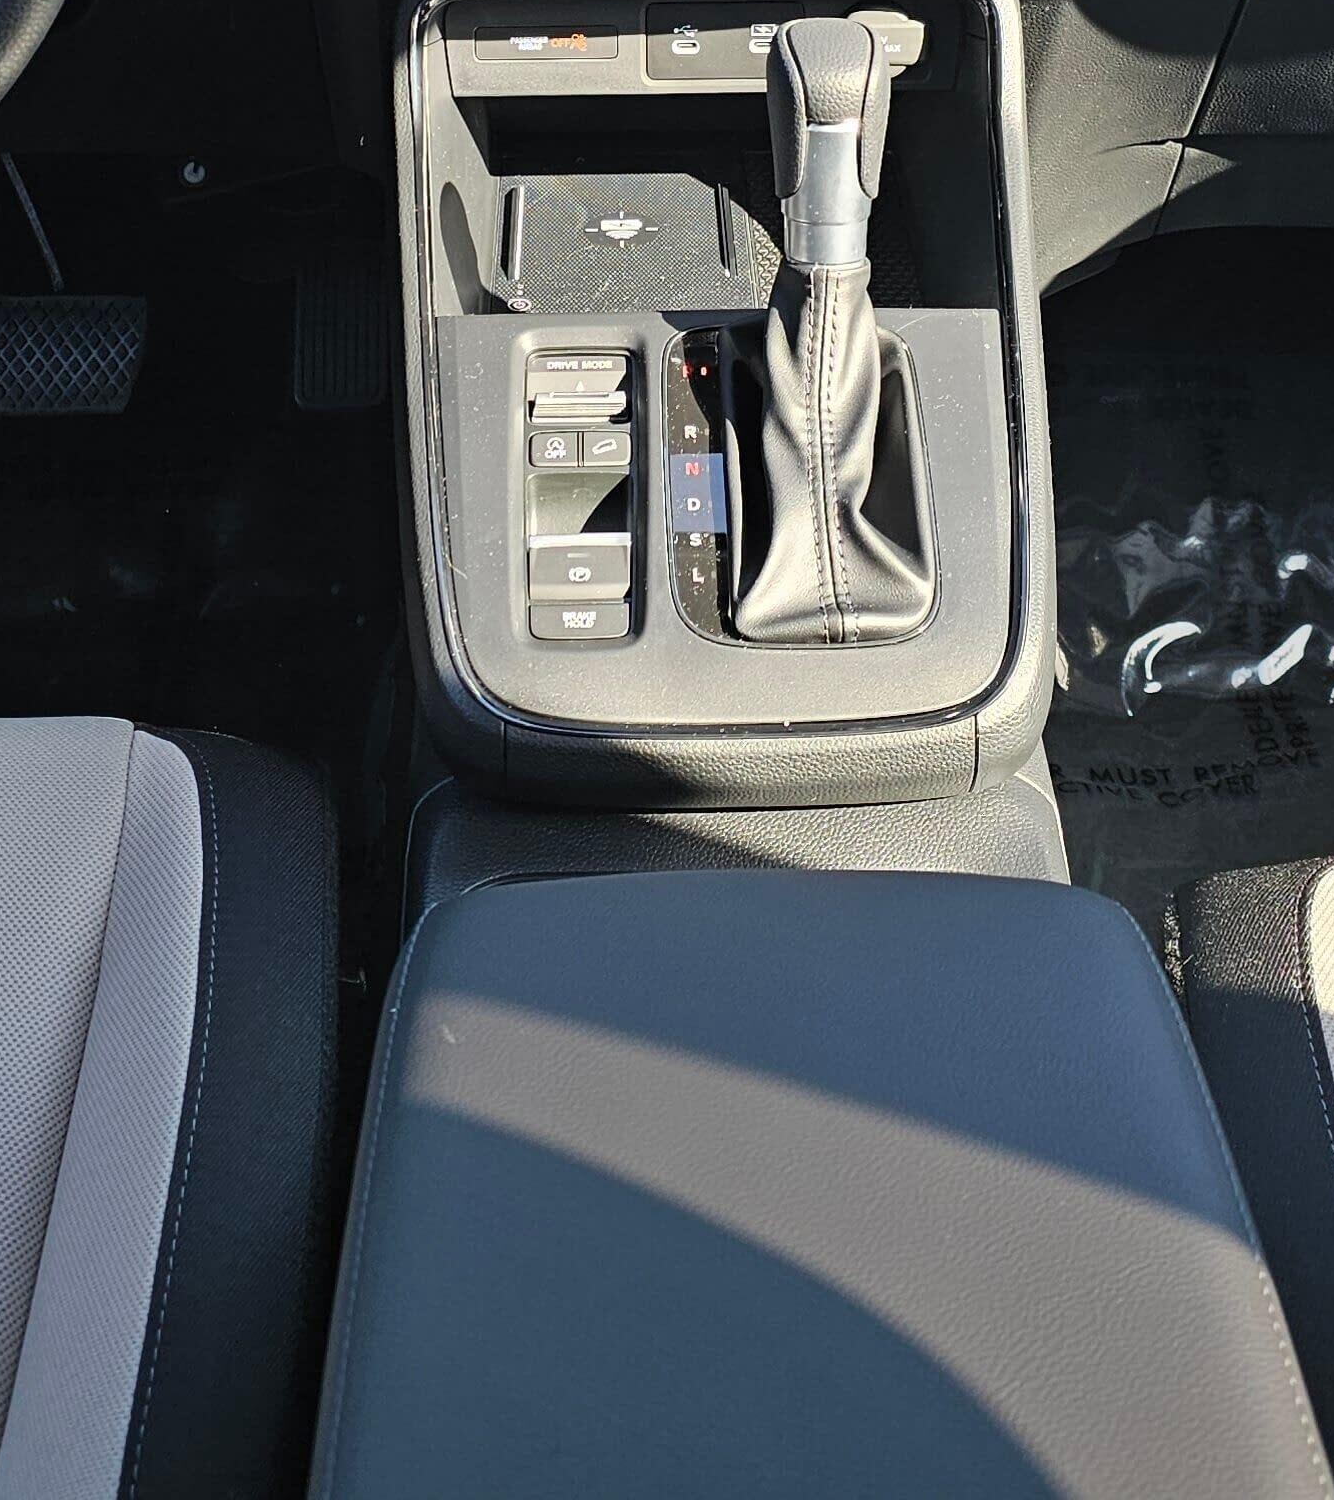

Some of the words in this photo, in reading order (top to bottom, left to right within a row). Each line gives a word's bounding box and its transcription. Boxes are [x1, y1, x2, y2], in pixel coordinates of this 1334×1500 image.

[547, 361, 578, 370] DRIVE
[582, 361, 612, 370] MODE
[684, 425, 697, 439] R
[545, 449, 567, 459] OFF
[685, 462, 699, 476] N
[687, 497, 701, 512] D
[689, 533, 702, 547] S
[692, 567, 705, 584] L
[562, 611, 597, 621] BRAKE
[564, 619, 595, 629] HOLD
[1087, 764, 1172, 787] MUST
